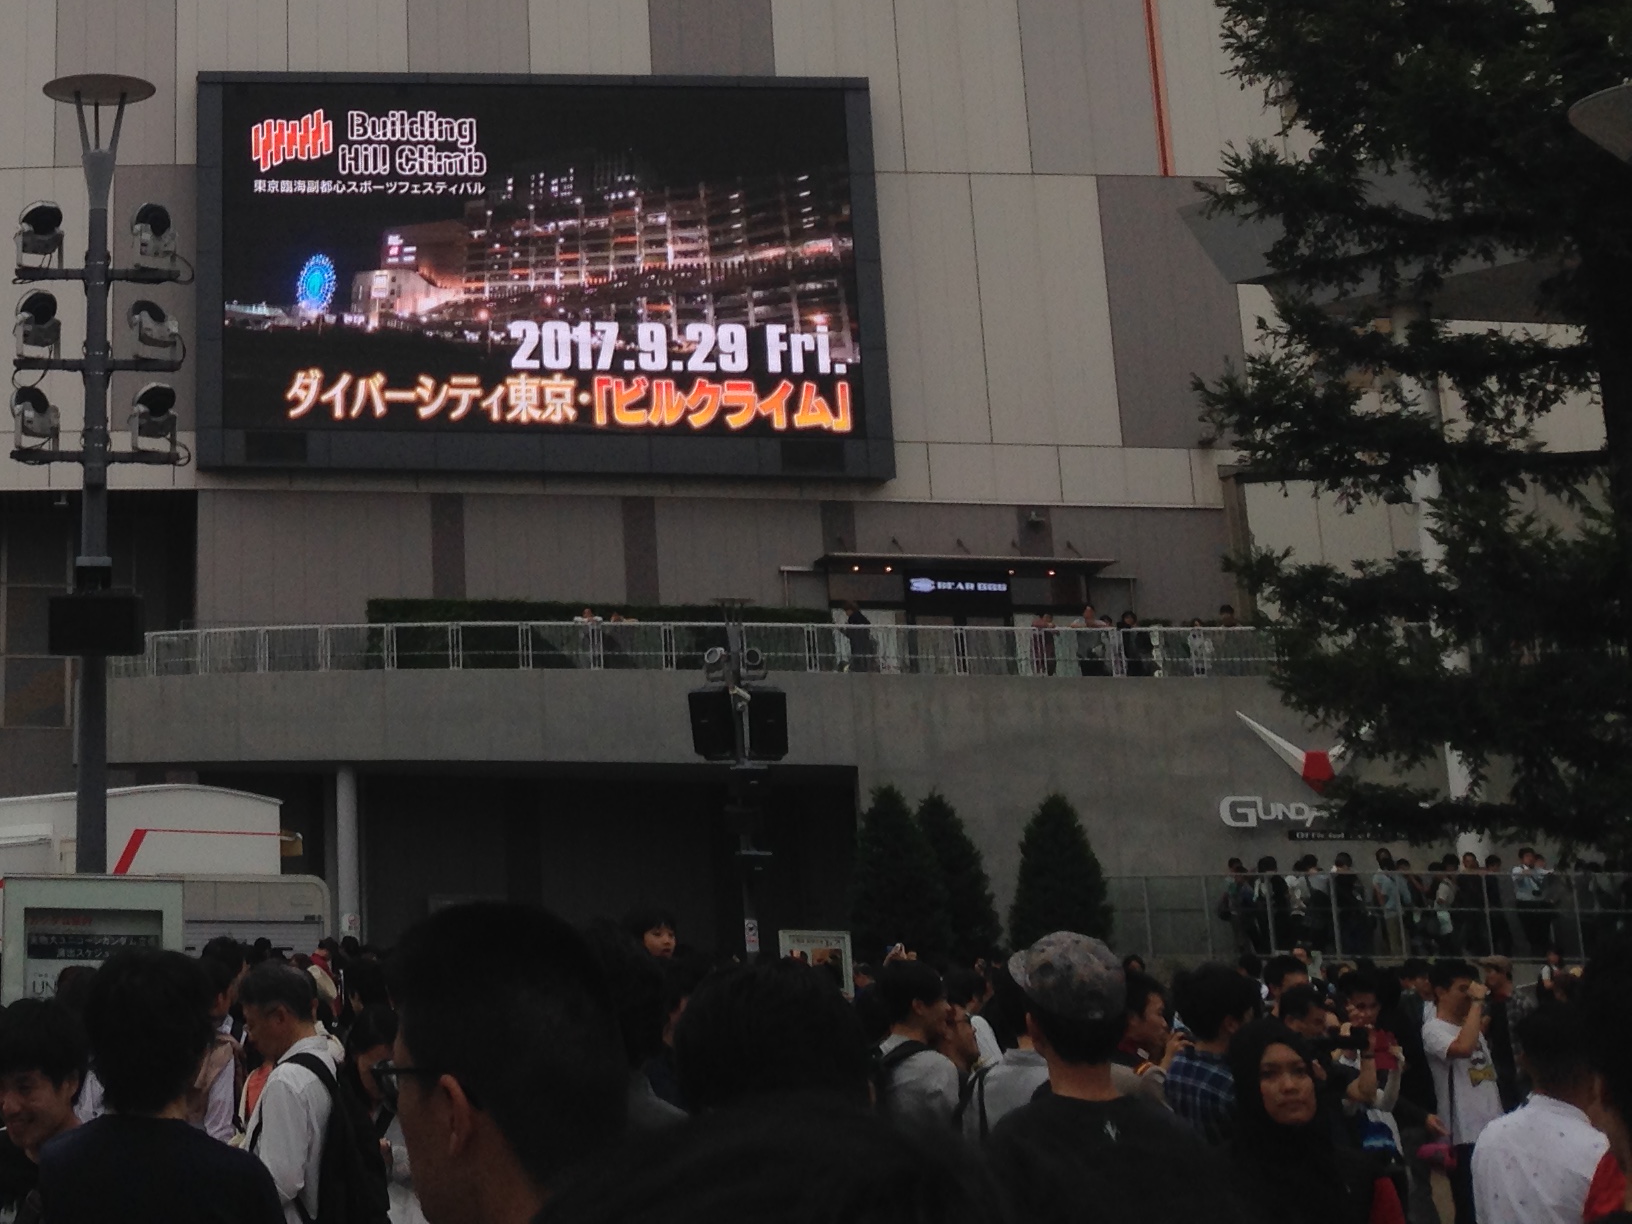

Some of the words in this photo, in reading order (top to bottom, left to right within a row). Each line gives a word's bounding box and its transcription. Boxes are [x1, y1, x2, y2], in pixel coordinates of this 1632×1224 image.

[348, 110, 476, 148] Building
[338, 144, 390, 176] Hill
[396, 145, 487, 176] Climb
[509, 320, 749, 373] 2017.9.29
[766, 323, 847, 375] Fri.
[1219, 796, 1334, 827] GUND
